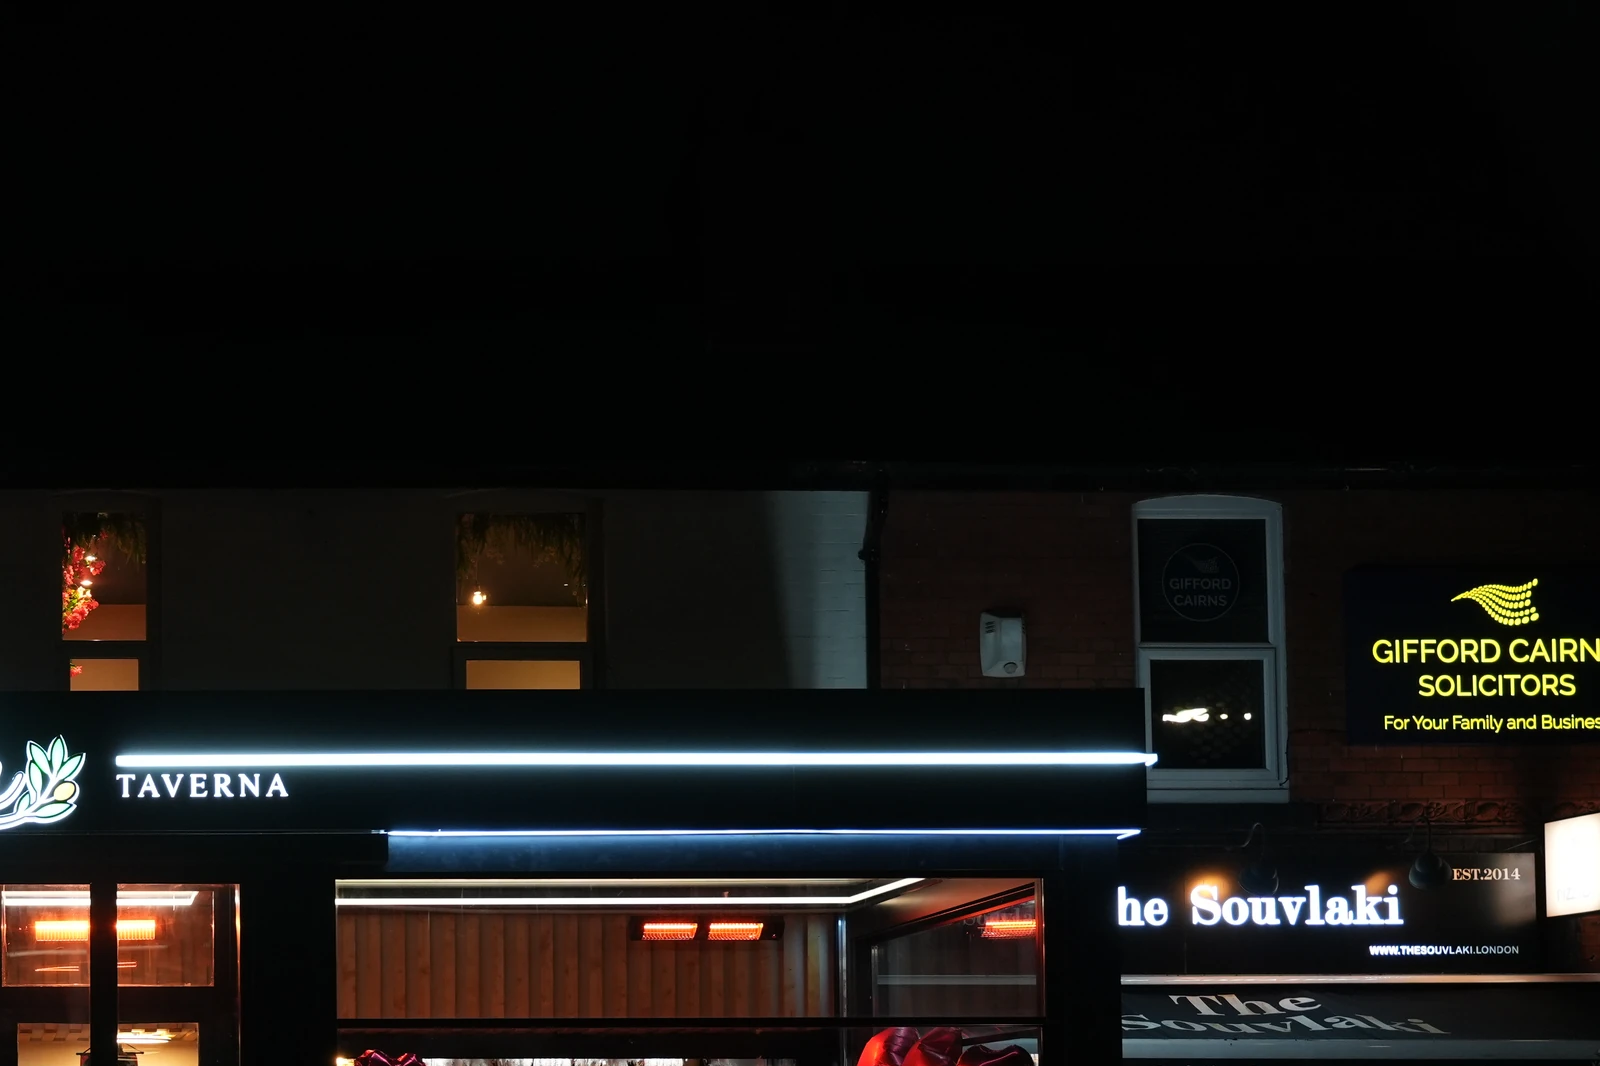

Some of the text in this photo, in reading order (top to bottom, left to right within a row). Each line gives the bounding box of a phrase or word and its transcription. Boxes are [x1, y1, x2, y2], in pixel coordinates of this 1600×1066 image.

[1169, 578, 1232, 590] GIFFORD
[1173, 594, 1228, 607] CAIRNS
[1371, 637, 1600, 664] GIFFORD CAIRN
[1417, 673, 1577, 697] SOLICITORS
[1384, 714, 1600, 734] For Your Family and Busines
[115, 772, 290, 800] TAVERNA
[1451, 867, 1522, 882] EST.2014
[1117, 883, 1404, 926] he Souvlaki
[1368, 944, 1520, 956] WWW.THESOUVLAKI.LONDON
[1168, 993, 1322, 1017] The
[1121, 1012, 1452, 1035] Souvlaki
